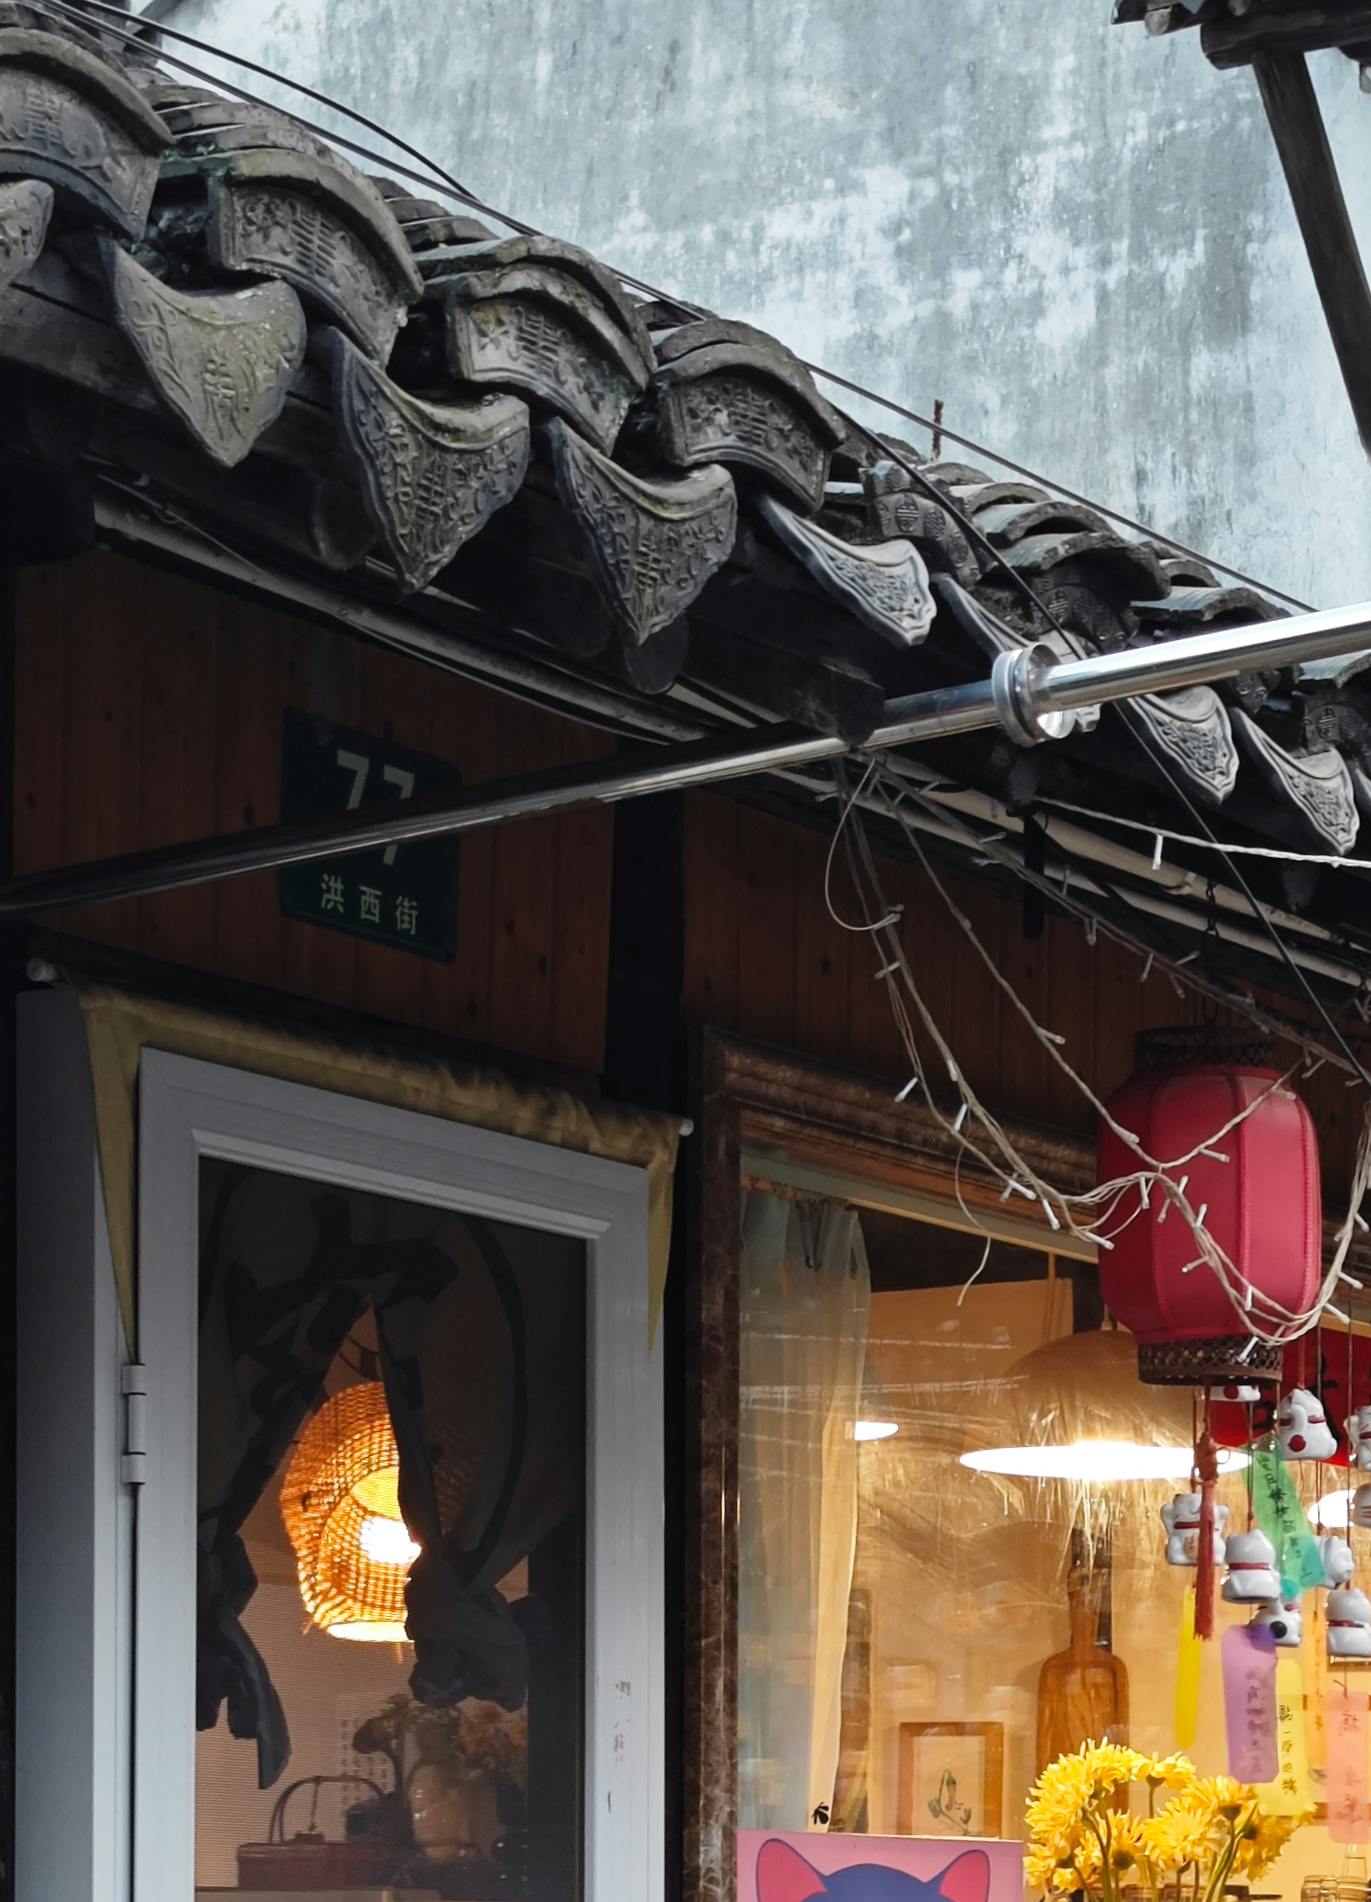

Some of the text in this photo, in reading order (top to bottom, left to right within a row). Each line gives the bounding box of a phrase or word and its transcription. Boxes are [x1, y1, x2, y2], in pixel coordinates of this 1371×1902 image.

[336, 748, 416, 867] 77
[320, 872, 419, 936] 洪西街
